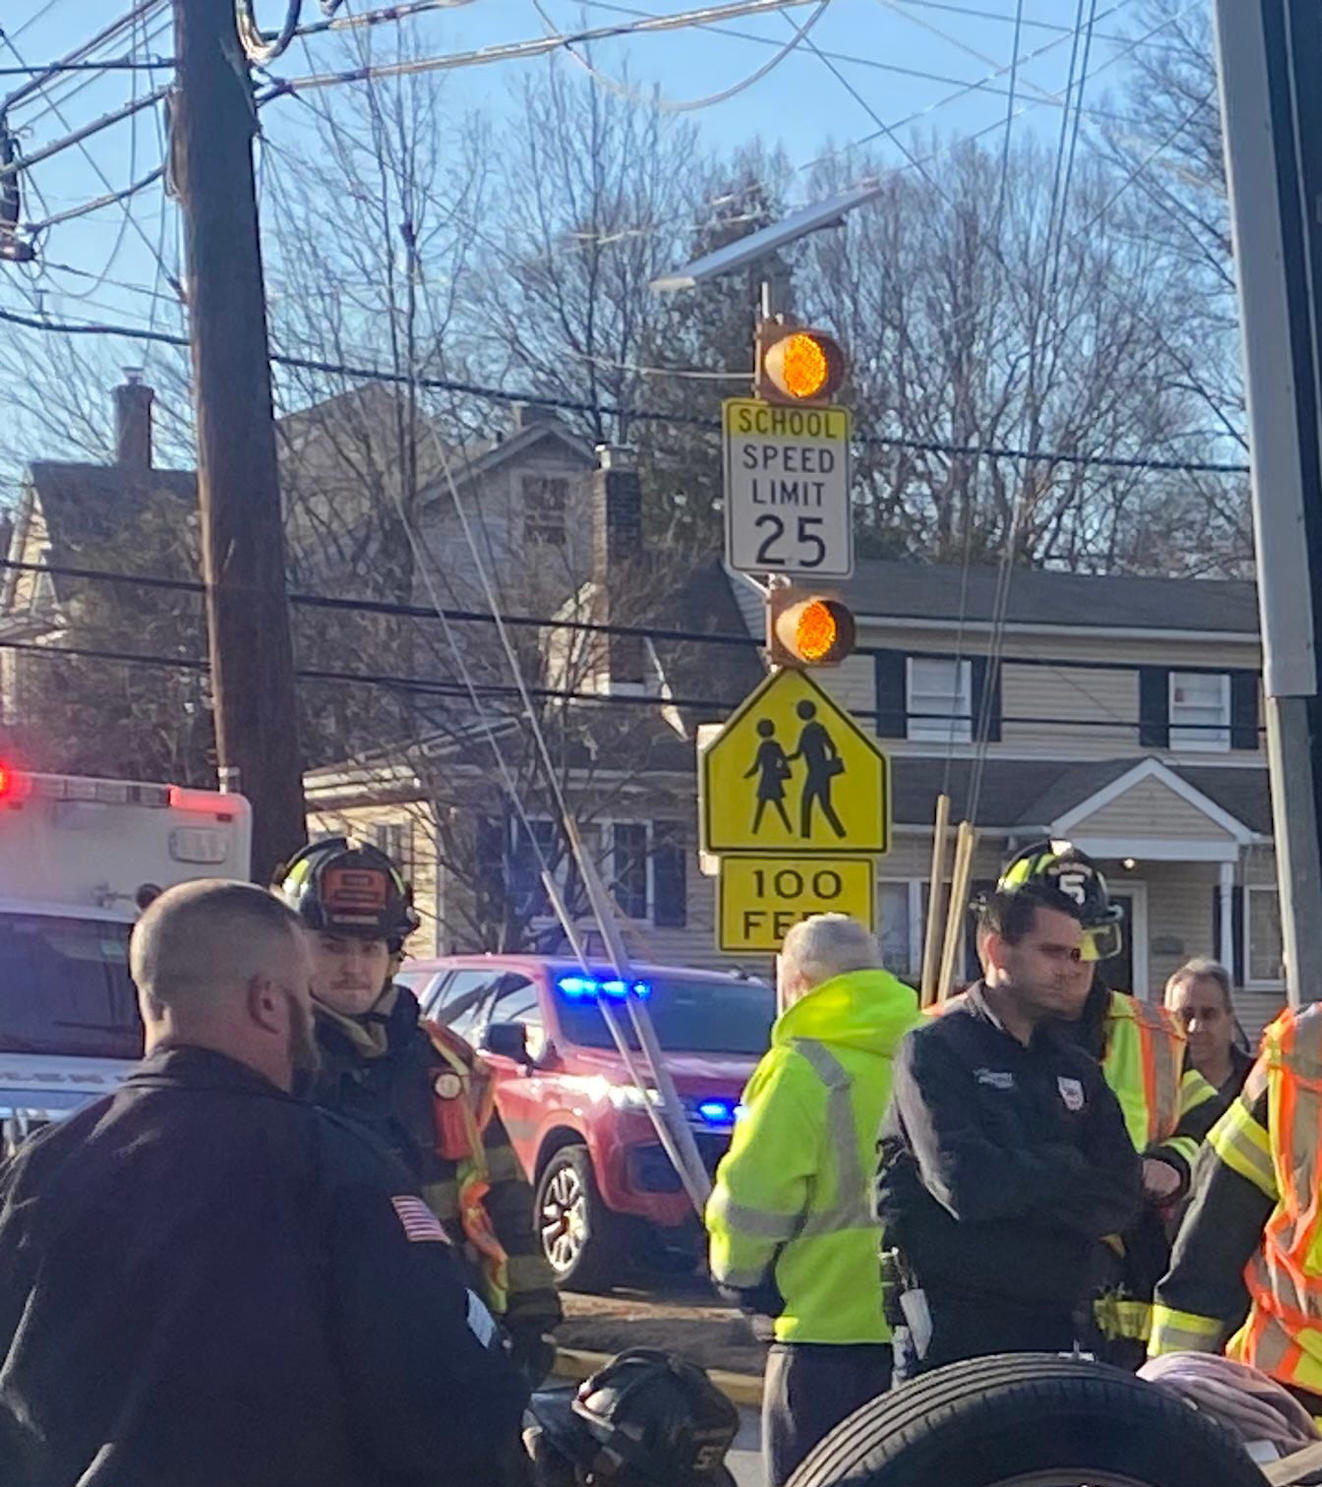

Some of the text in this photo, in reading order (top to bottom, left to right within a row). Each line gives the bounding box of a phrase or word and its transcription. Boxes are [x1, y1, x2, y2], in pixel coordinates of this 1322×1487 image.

[739, 408, 837, 439] SCHOOL
[743, 444, 835, 474] SPEED
[752, 478, 825, 507] LIMIT
[755, 514, 826, 568] 25
[752, 869, 842, 899] 100
[743, 911, 851, 940] FE
